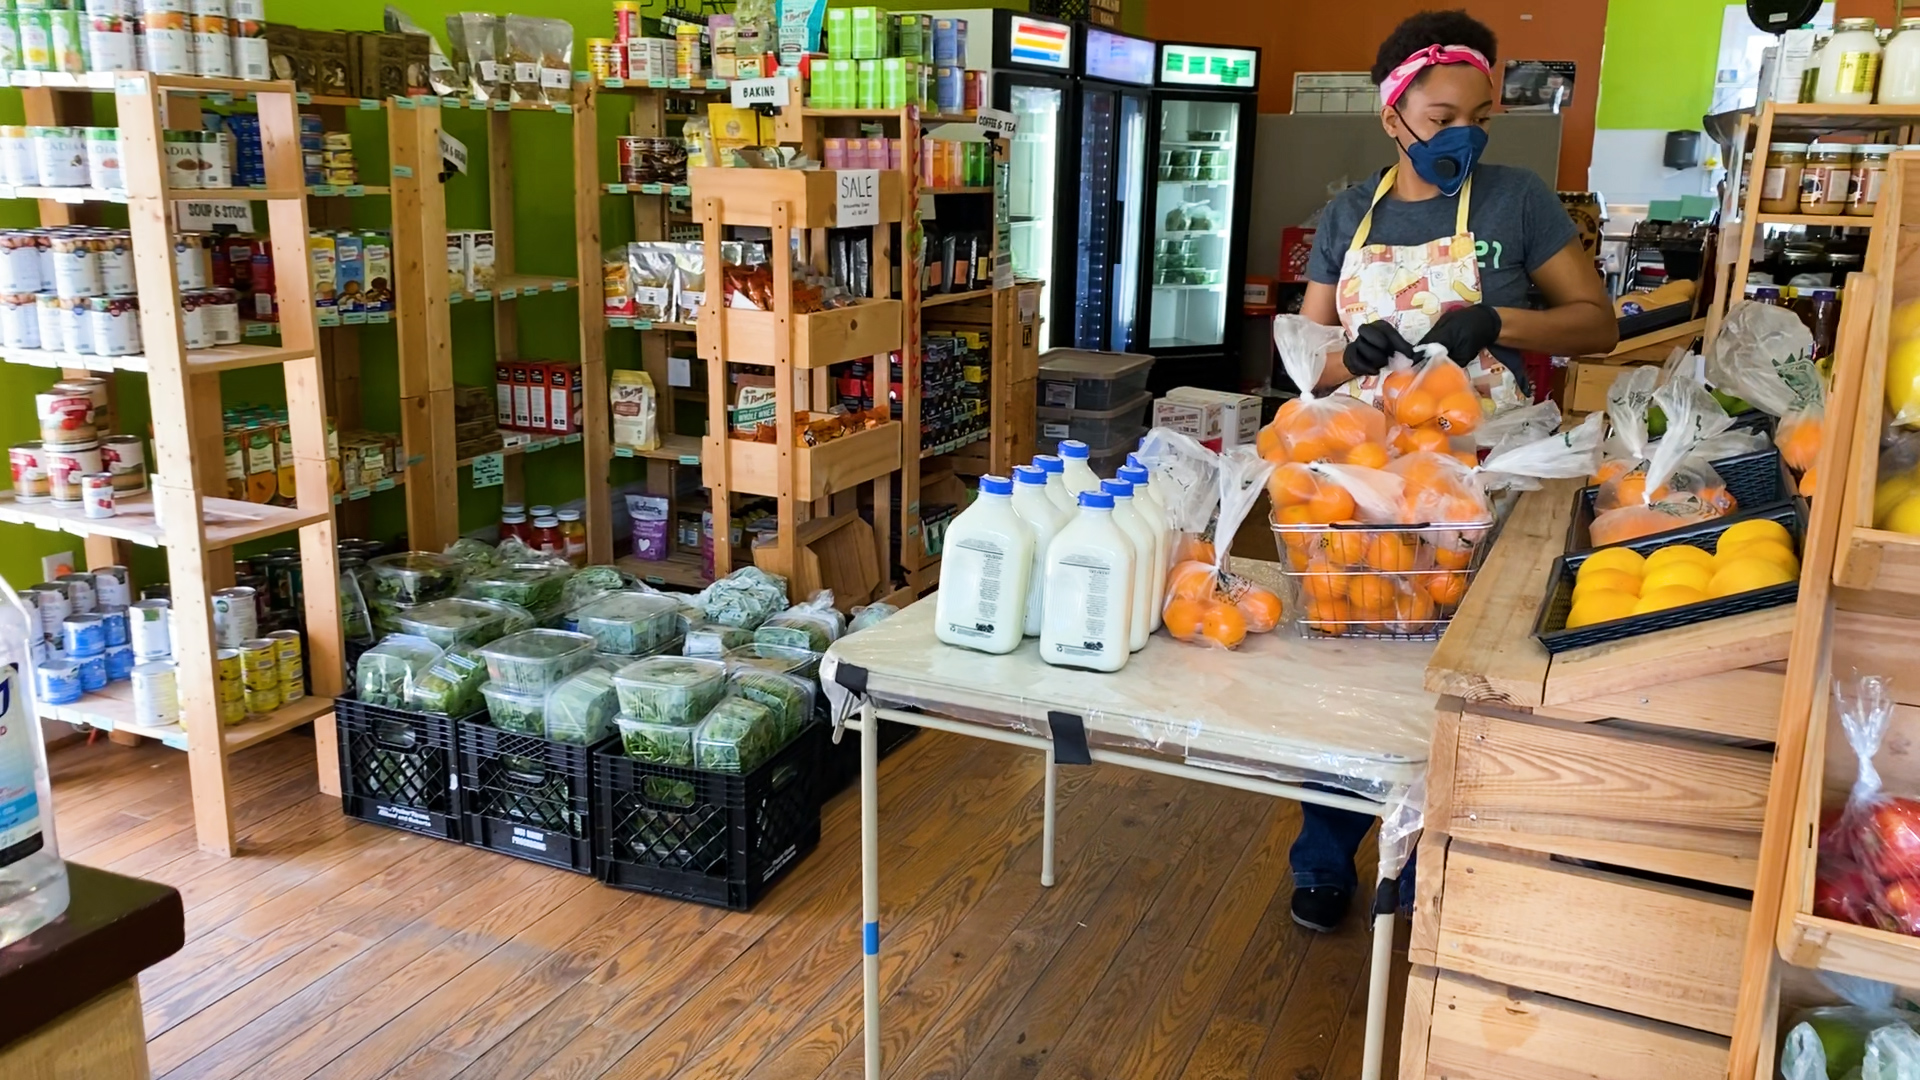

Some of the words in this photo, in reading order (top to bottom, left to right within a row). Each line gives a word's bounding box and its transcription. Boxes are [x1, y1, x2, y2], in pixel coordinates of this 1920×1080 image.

[742, 85, 776, 98] BAKING
[978, 115, 998, 129] COFFEE
[1004, 121, 1017, 133] TEA
[841, 175, 873, 199] SALE
[188, 203, 212, 217] SOUP
[214, 205, 221, 217] &
[222, 205, 248, 219] STOCK
[738, 411, 757, 422] WHOLE
[758, 408, 776, 418] WHEA
